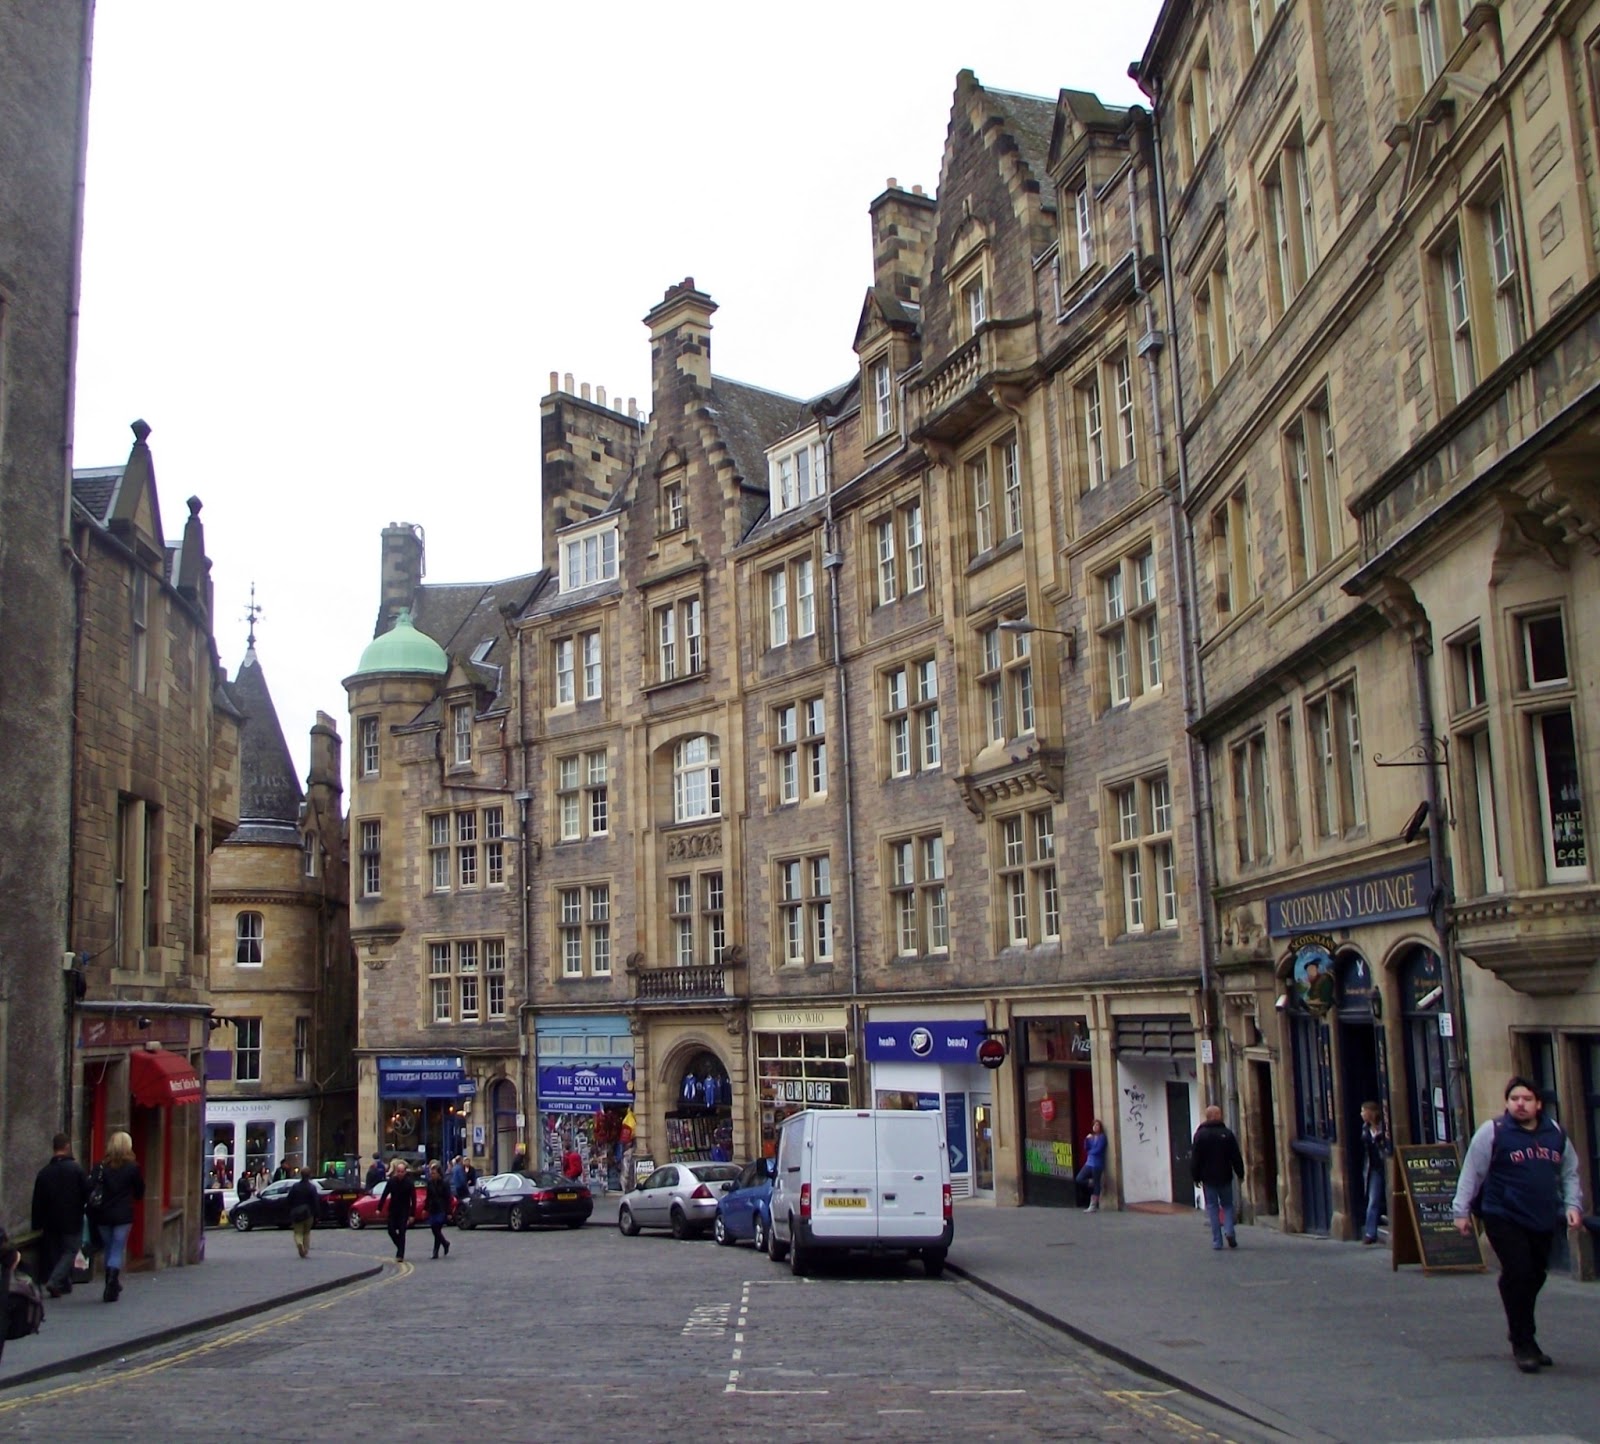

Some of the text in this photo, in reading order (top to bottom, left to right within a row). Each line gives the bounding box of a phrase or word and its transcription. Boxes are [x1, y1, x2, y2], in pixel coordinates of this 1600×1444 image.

[1555, 811, 1581, 821] KILT
[1280, 873, 1417, 928] SCOTSMAN'S LOUNGE
[777, 1012, 824, 1024] WHO'S WHO
[878, 1036, 896, 1047] health
[946, 1036, 968, 1049] beauty
[385, 1073, 420, 1081] SOUTHERN
[421, 1072, 442, 1080] CROSS
[557, 1076, 617, 1086] THE SCOTSMAN
[806, 1083, 831, 1101] OFF
[1509, 1146, 1561, 1163] NIKE
